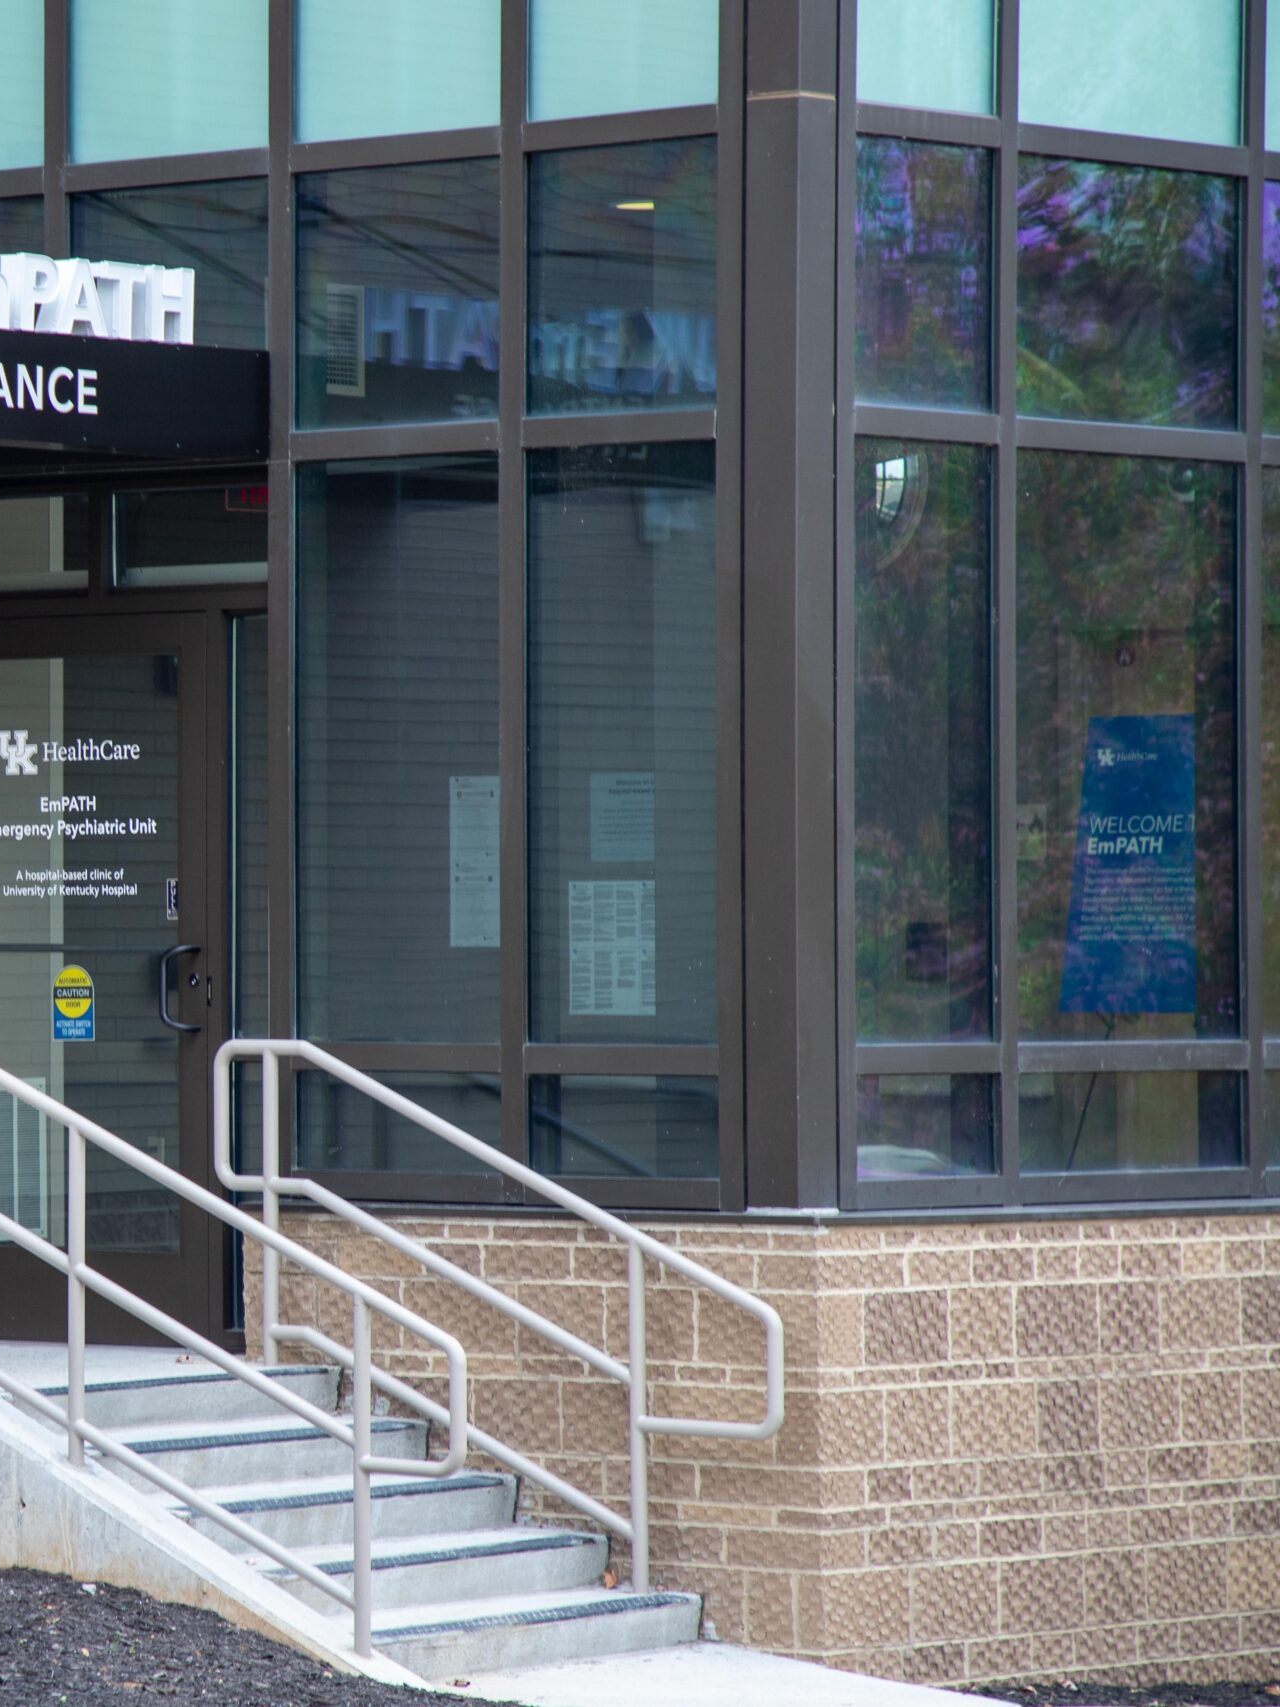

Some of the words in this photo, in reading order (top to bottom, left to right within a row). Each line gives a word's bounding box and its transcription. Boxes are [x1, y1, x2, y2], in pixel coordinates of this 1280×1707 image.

[42, 738, 141, 762] HealthCare
[40, 796, 97, 812] EmPATH
[57, 818, 127, 840] Psychiatric
[129, 818, 157, 835] Unit
[1089, 815, 1183, 834] WELCOME
[1087, 836, 1164, 855] EmPATH
[16, 870, 24, 881] A
[25, 868, 88, 883] hospital-based
[90, 869, 113, 881] clinic
[114, 868, 124, 880] of
[3, 885, 45, 898] University
[47, 885, 57, 896] of
[59, 885, 100, 898] Kentucky
[101, 884, 138, 898] Hospital
[57, 988, 89, 997] CAUTION
